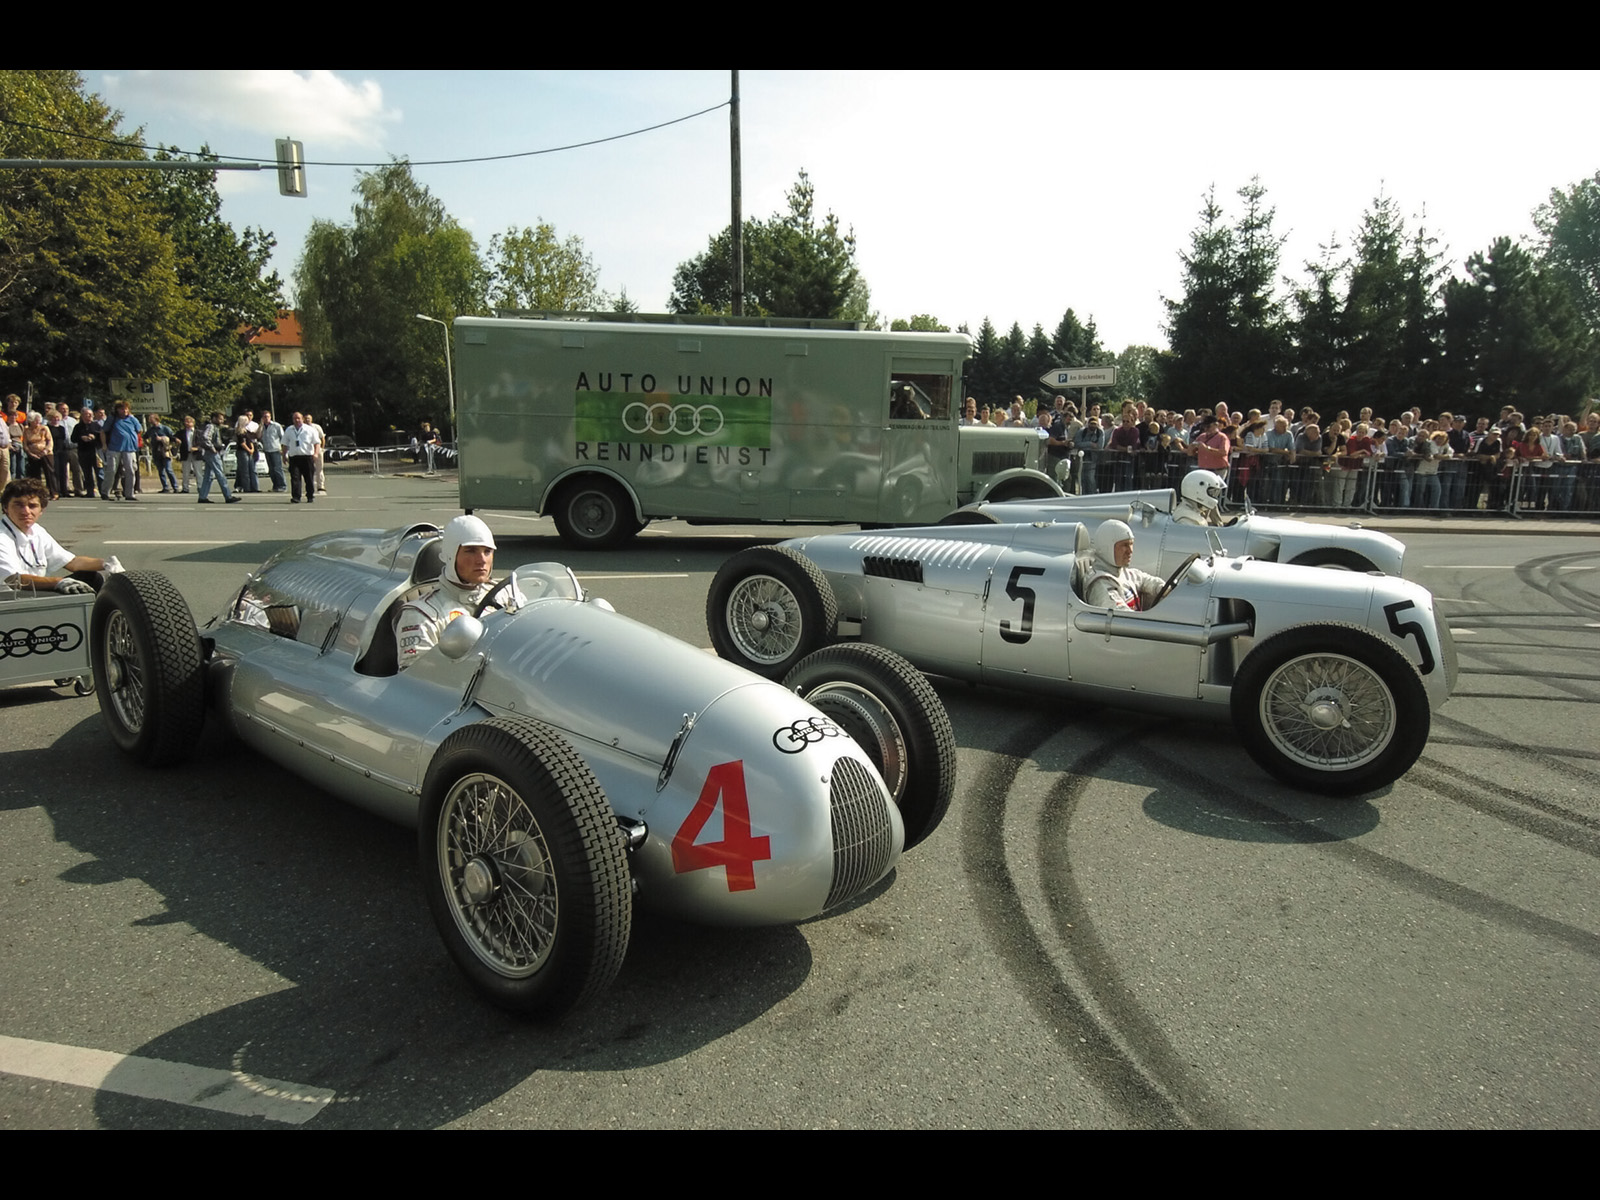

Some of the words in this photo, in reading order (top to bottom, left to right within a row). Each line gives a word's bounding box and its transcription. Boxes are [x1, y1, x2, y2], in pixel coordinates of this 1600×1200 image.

[575, 372, 656, 393] AUTO
[678, 375, 772, 397] UNION
[575, 441, 771, 466] RENNDIENST
[1000, 566, 1046, 645] 5
[0, 640, 26, 648] AUTO
[31, 636, 64, 644] UNION
[1383, 600, 1435, 675] 5
[793, 727, 814, 740] AUTO
[671, 759, 771, 892] 4
